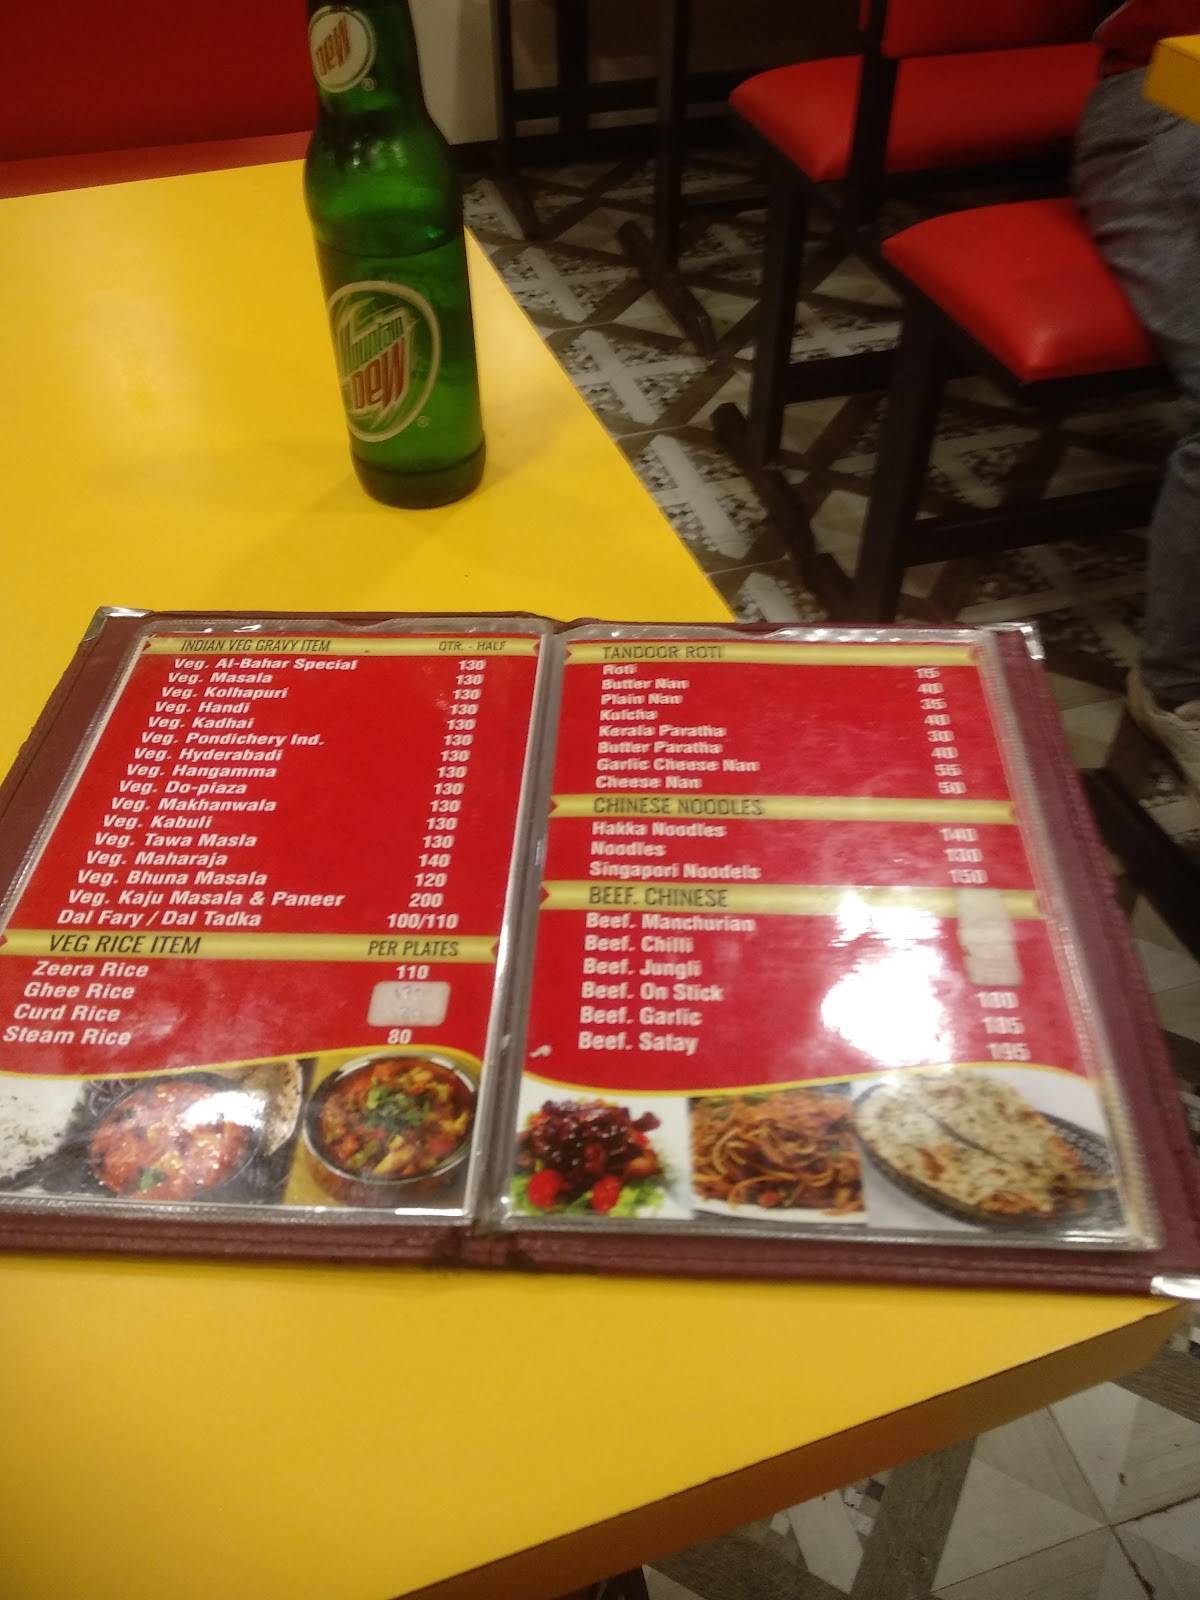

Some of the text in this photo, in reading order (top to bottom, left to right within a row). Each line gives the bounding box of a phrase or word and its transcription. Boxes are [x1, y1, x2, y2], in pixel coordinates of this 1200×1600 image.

[181, 640, 331, 651] INDIAN VEG GRAVY ITEM
[477, 641, 507, 651] HALF
[603, 646, 723, 659] TANDOOR ROTI
[174, 658, 358, 672] Veg. Al-Bahar Special
[458, 660, 487, 671] 130
[602, 664, 638, 675] Roti
[168, 672, 272, 684] Veg. Masala
[455, 674, 484, 685] 130
[601, 678, 690, 690] Butter Nan
[162, 686, 288, 700] Veg. Kolhapuri
[452, 688, 482, 700] 130
[601, 694, 683, 705] Plain Nan
[155, 702, 250, 714] Veg. Handi
[450, 704, 479, 715] 130
[148, 716, 254, 730] Veg. Kadhai
[447, 719, 476, 730] 130
[598, 724, 727, 738] Kerala Paratha
[141, 732, 324, 748] Veg. Pondichery Ind.
[444, 734, 474, 746] 130
[598, 741, 723, 754] Butter Paratha
[134, 748, 284, 762] Veg. Hyderabadi
[440, 750, 471, 762] 130
[127, 764, 277, 779] Veg. Hangamma
[437, 766, 468, 779] 130
[596, 758, 760, 772] Garlic Cheese Nan
[119, 780, 248, 796] Veg. Do-piaza
[433, 782, 464, 796] 130
[596, 776, 702, 789] Cheese Nan
[111, 797, 277, 812] Veg. Makhanwala
[430, 799, 462, 813] 130
[594, 797, 764, 816] CHINESE NOODLES
[103, 814, 212, 830] Veg. Kabuli
[426, 817, 458, 830] 130
[592, 822, 727, 838] Hakka Noodles
[95, 832, 258, 848] Veg. Tawa Masla
[422, 835, 455, 848] 130
[590, 841, 666, 856] Noodles
[86, 850, 228, 868] Veg. Maharaja
[418, 854, 452, 868] 140
[589, 860, 762, 880] Singapori Noodels
[78, 870, 268, 886] Veg. Bhuna Masala
[414, 872, 448, 888] 120
[68, 889, 345, 907] Veg. Kaju Masala & Paneer
[408, 892, 444, 908] 200
[589, 886, 729, 908] BEEF. CHINESE
[57, 910, 262, 928] Dal Fary / Dal Tadka
[386, 913, 460, 929] 100/110
[586, 912, 756, 932] Beef. Manchurian
[50, 934, 202, 954] VEG RICE ITEM
[367, 940, 460, 956] PER PLATES
[584, 934, 694, 953] Beef. Chilli
[32, 960, 150, 978] Zeera Rice
[396, 964, 430, 980] 110
[583, 957, 702, 980] Beef. Jungli
[24, 982, 136, 1000] Ghee Rice
[581, 981, 724, 1002] Beef. On Stick
[14, 1004, 121, 1022] Curd Rice
[580, 1006, 702, 1026] Beef. Garlic
[2, 1026, 132, 1046] Steam Rice
[387, 1028, 412, 1044] 80
[578, 1030, 698, 1056] Beef. Satay
